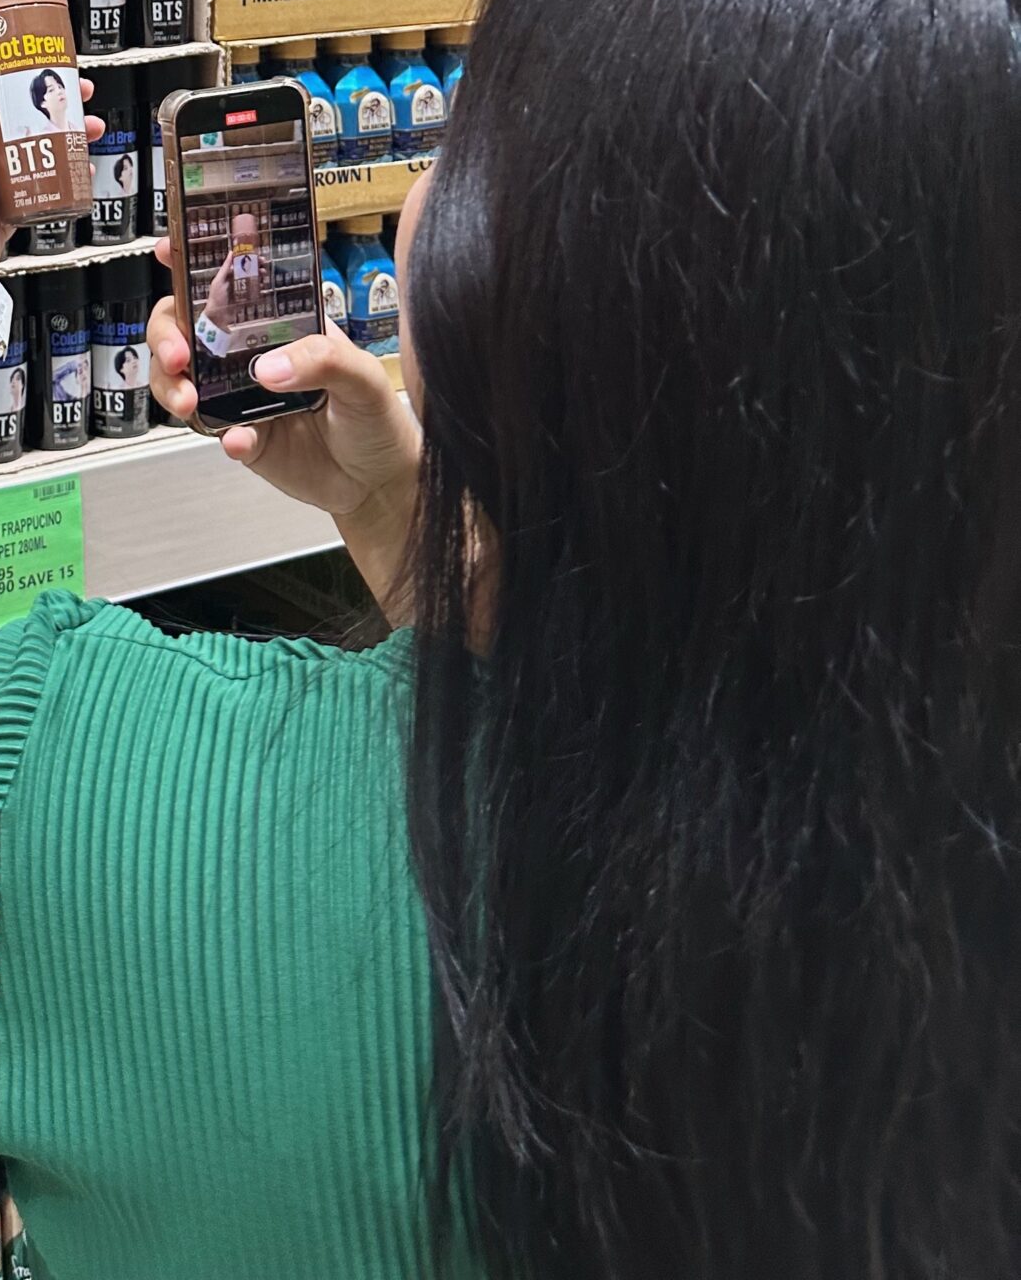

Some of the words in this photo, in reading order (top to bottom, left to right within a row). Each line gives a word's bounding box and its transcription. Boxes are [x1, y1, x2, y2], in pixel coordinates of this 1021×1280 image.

[152, 1, 182, 21] BTS
[22, 34, 65, 55] Brew
[36, 56, 56, 64] Mocha
[5, 138, 56, 176] BTS
[10, 175, 31, 184] SPECIAL
[33, 170, 56, 179] PACKAGE
[2, 511, 62, 537] FRAPPUCINO
[19, 536, 47, 555] 280ML
[19, 570, 54, 590] SAVE
[60, 565, 74, 580] 15
